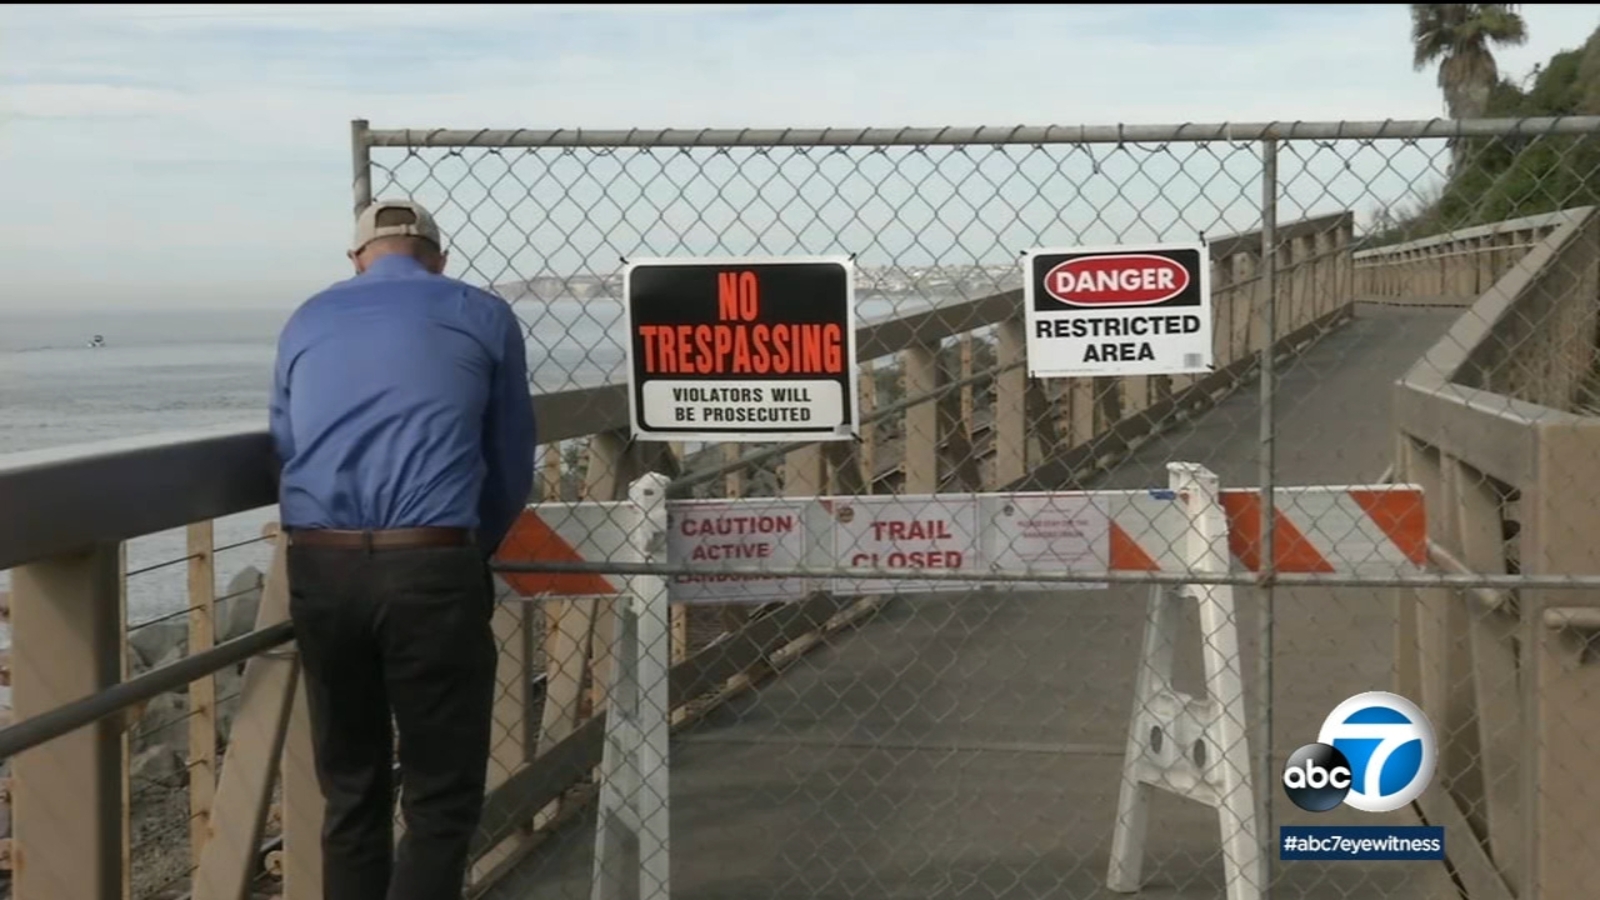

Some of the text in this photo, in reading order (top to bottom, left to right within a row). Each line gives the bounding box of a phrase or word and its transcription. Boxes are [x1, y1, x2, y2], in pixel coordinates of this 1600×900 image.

[1056, 267, 1176, 293] DANGER
[718, 271, 758, 321] NO
[1036, 315, 1201, 338] RESTRICTED
[639, 323, 842, 374] TRESPASSING
[1083, 342, 1155, 363] AREA
[672, 388, 812, 402] VIOLATORS WILL
[675, 407, 811, 421] BE PROSECUTED
[681, 515, 792, 536] CAUTION
[870, 520, 952, 541] TRAIL
[692, 543, 770, 561] ACTIVE
